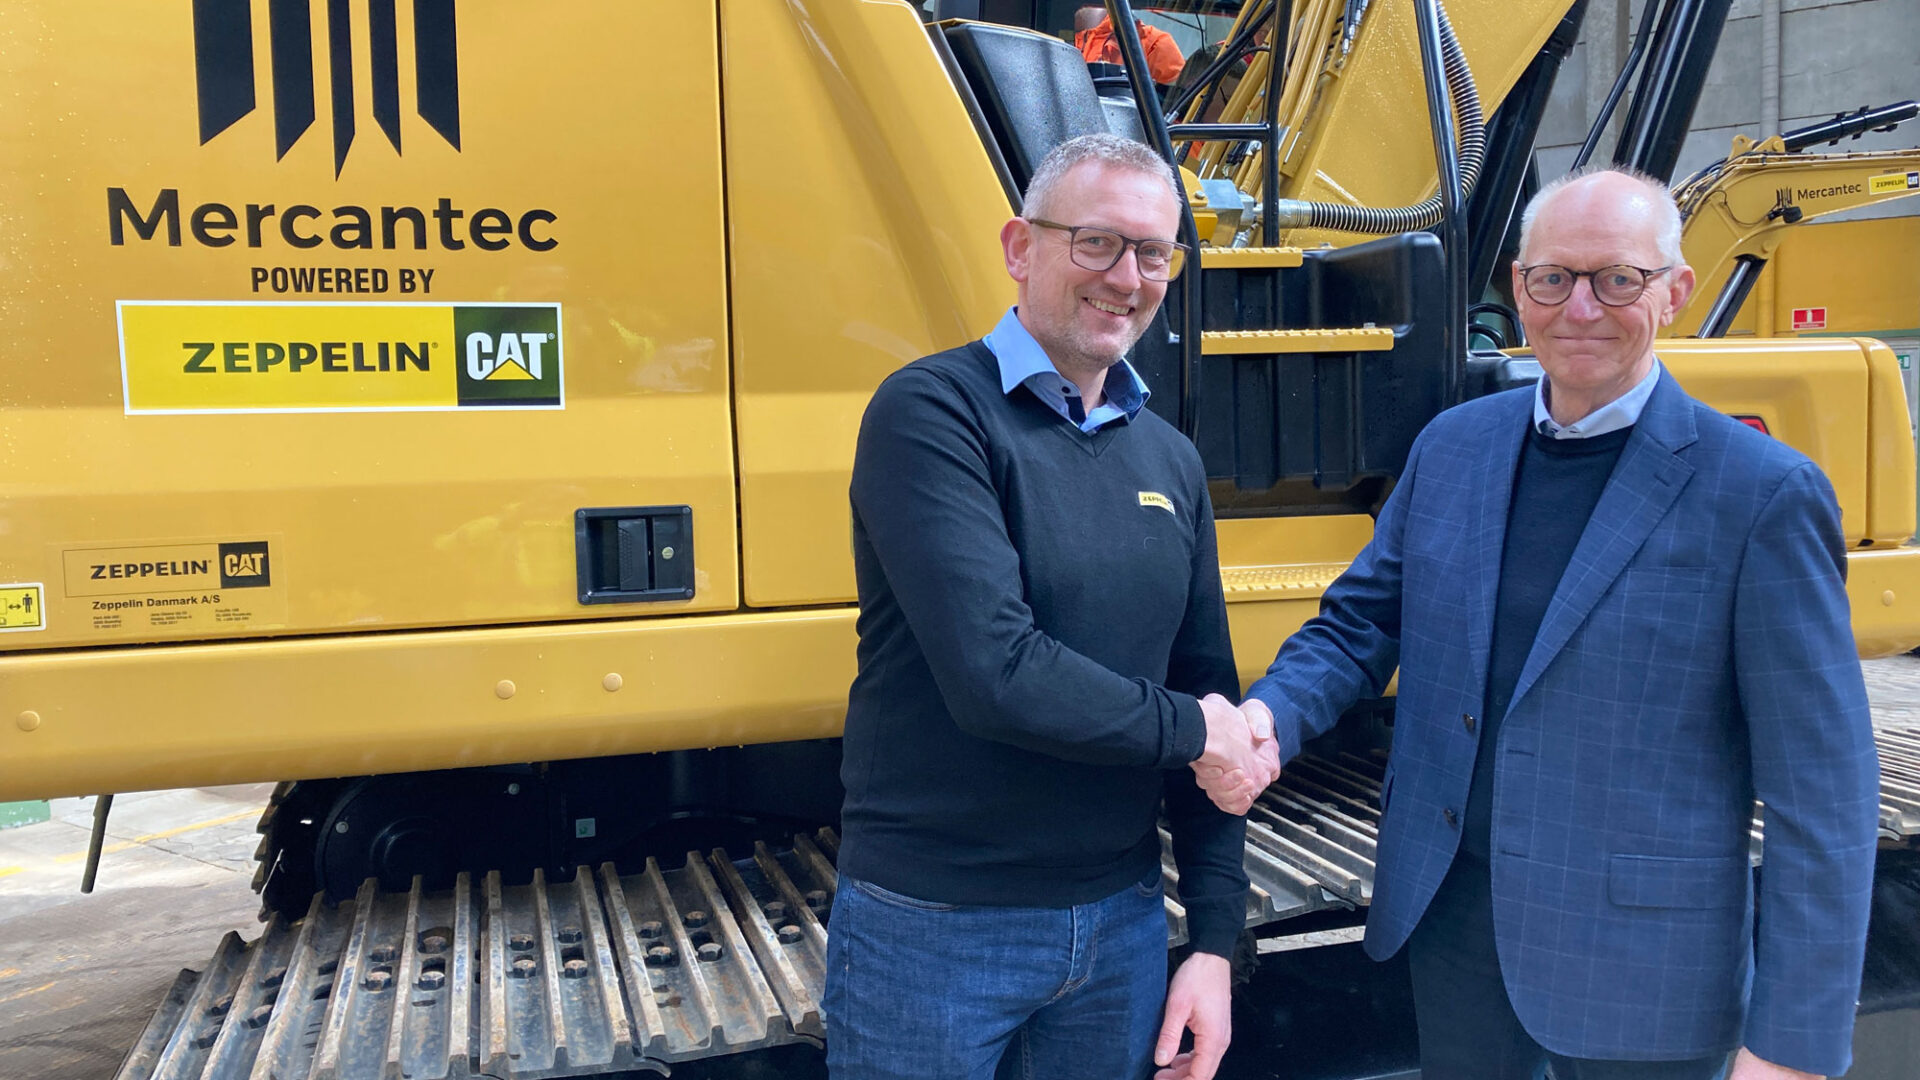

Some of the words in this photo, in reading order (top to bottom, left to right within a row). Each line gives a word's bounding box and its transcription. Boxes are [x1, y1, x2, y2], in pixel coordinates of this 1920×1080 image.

[1797, 184, 1862, 201] Mercantec
[107, 187, 558, 252] Mercantec
[251, 267, 388, 293] POWERED
[399, 268, 434, 294] BY
[183, 342, 431, 373] ZEPPELIN
[466, 332, 547, 380] CAT
[90, 560, 208, 579] ZEPPELIN
[224, 553, 263, 577] CAT
[92, 599, 143, 611] Zeppelin
[147, 595, 198, 606] Danmark
[201, 594, 221, 604] A/S
